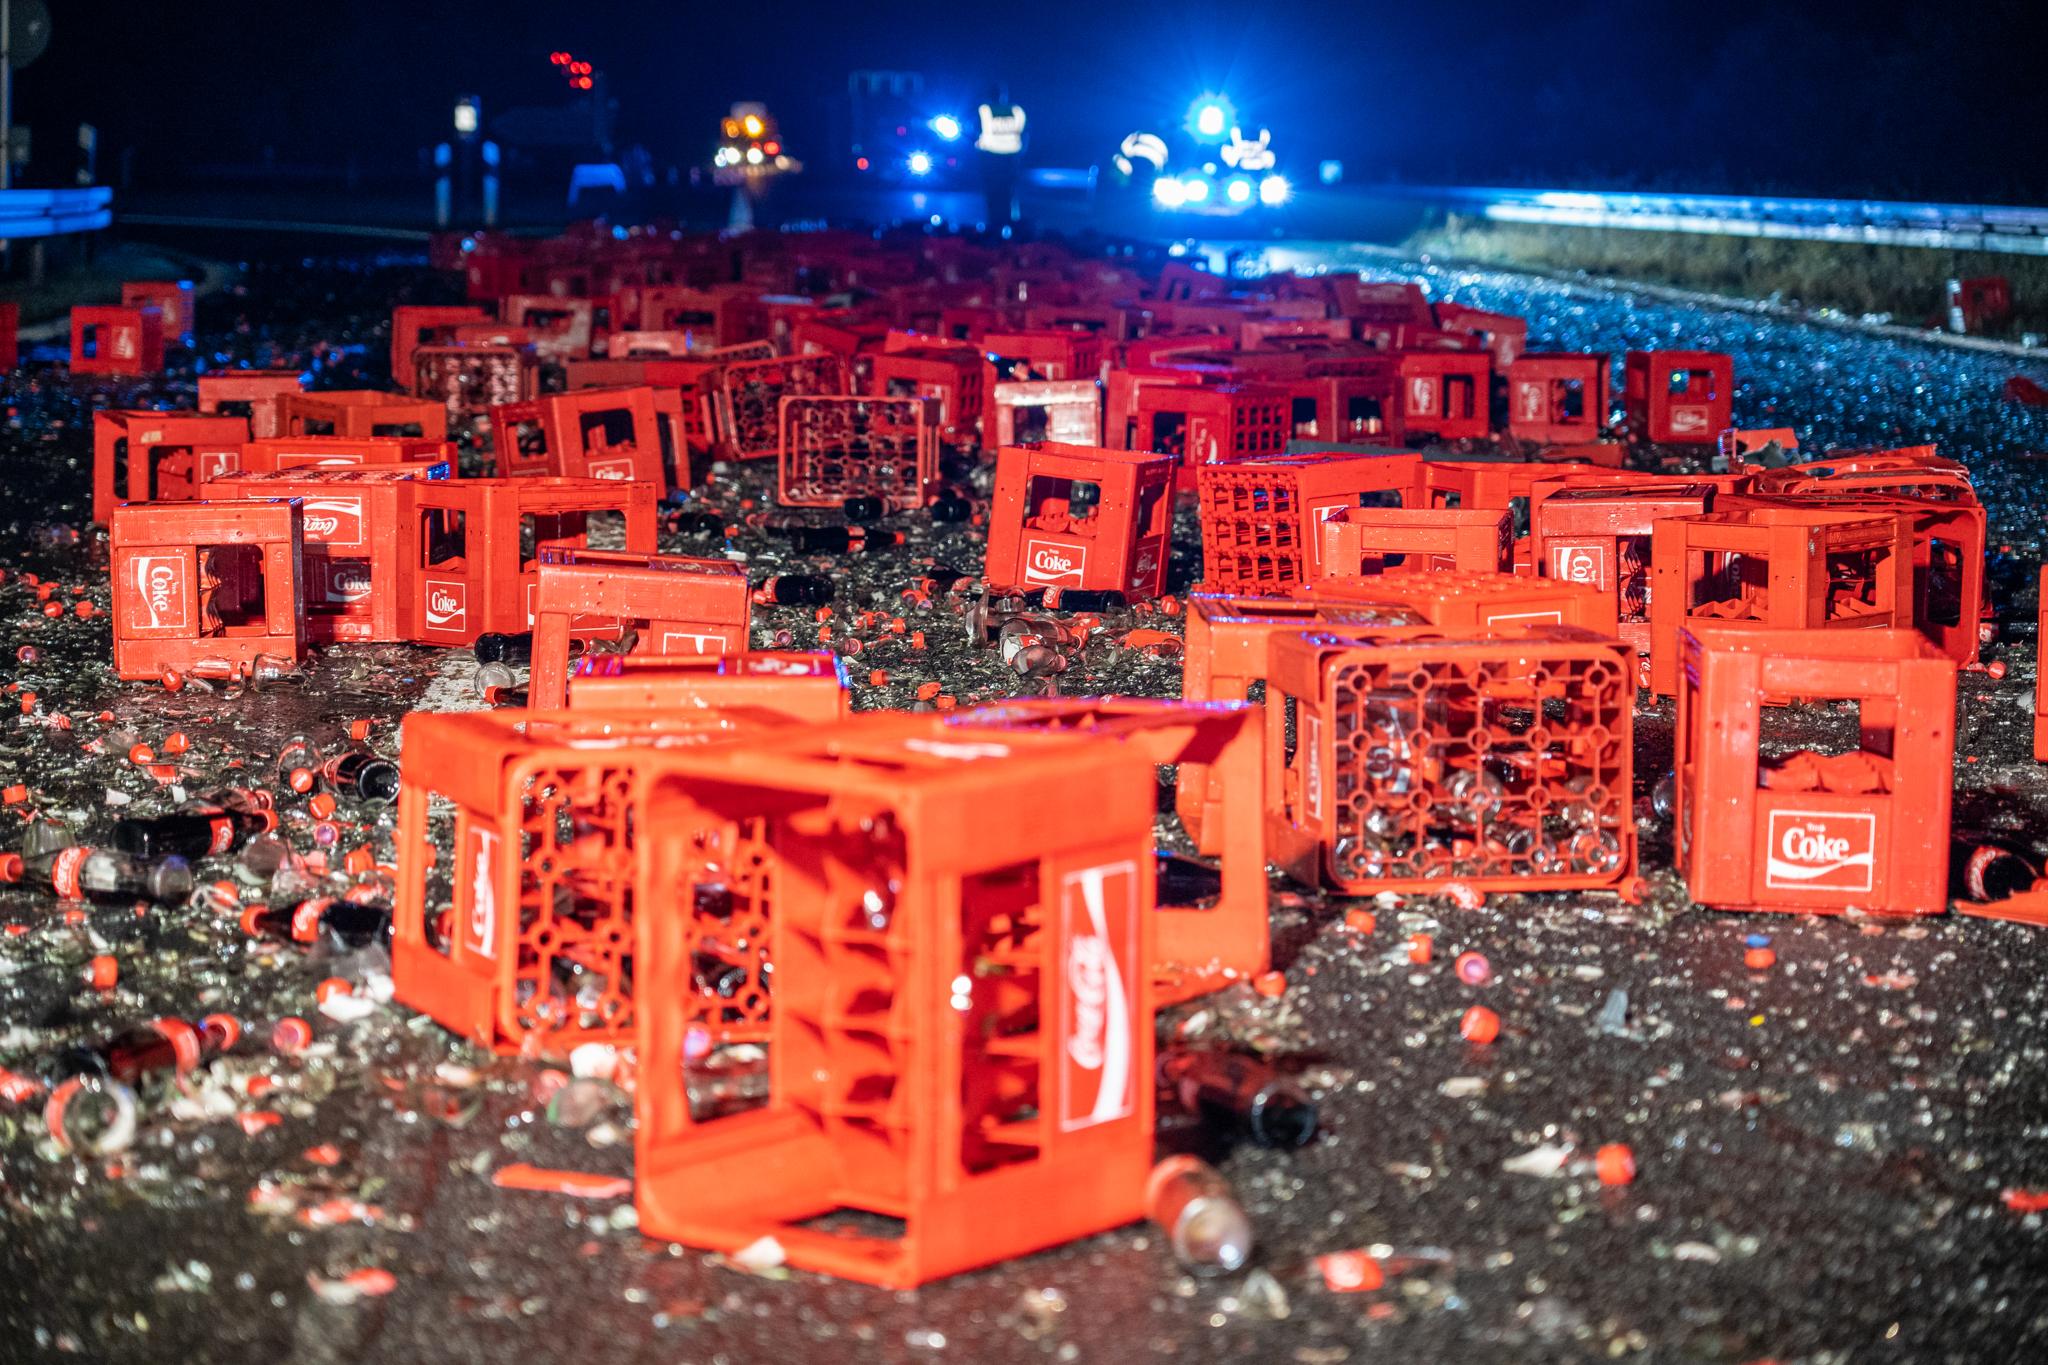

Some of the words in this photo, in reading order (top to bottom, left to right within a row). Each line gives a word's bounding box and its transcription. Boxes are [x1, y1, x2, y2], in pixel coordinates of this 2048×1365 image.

[1035, 550, 1072, 572] Coke
[1572, 555, 1593, 583] Co
[151, 566, 173, 612] Coke
[432, 591, 457, 613] Coke
[1782, 827, 1850, 863] Coke
